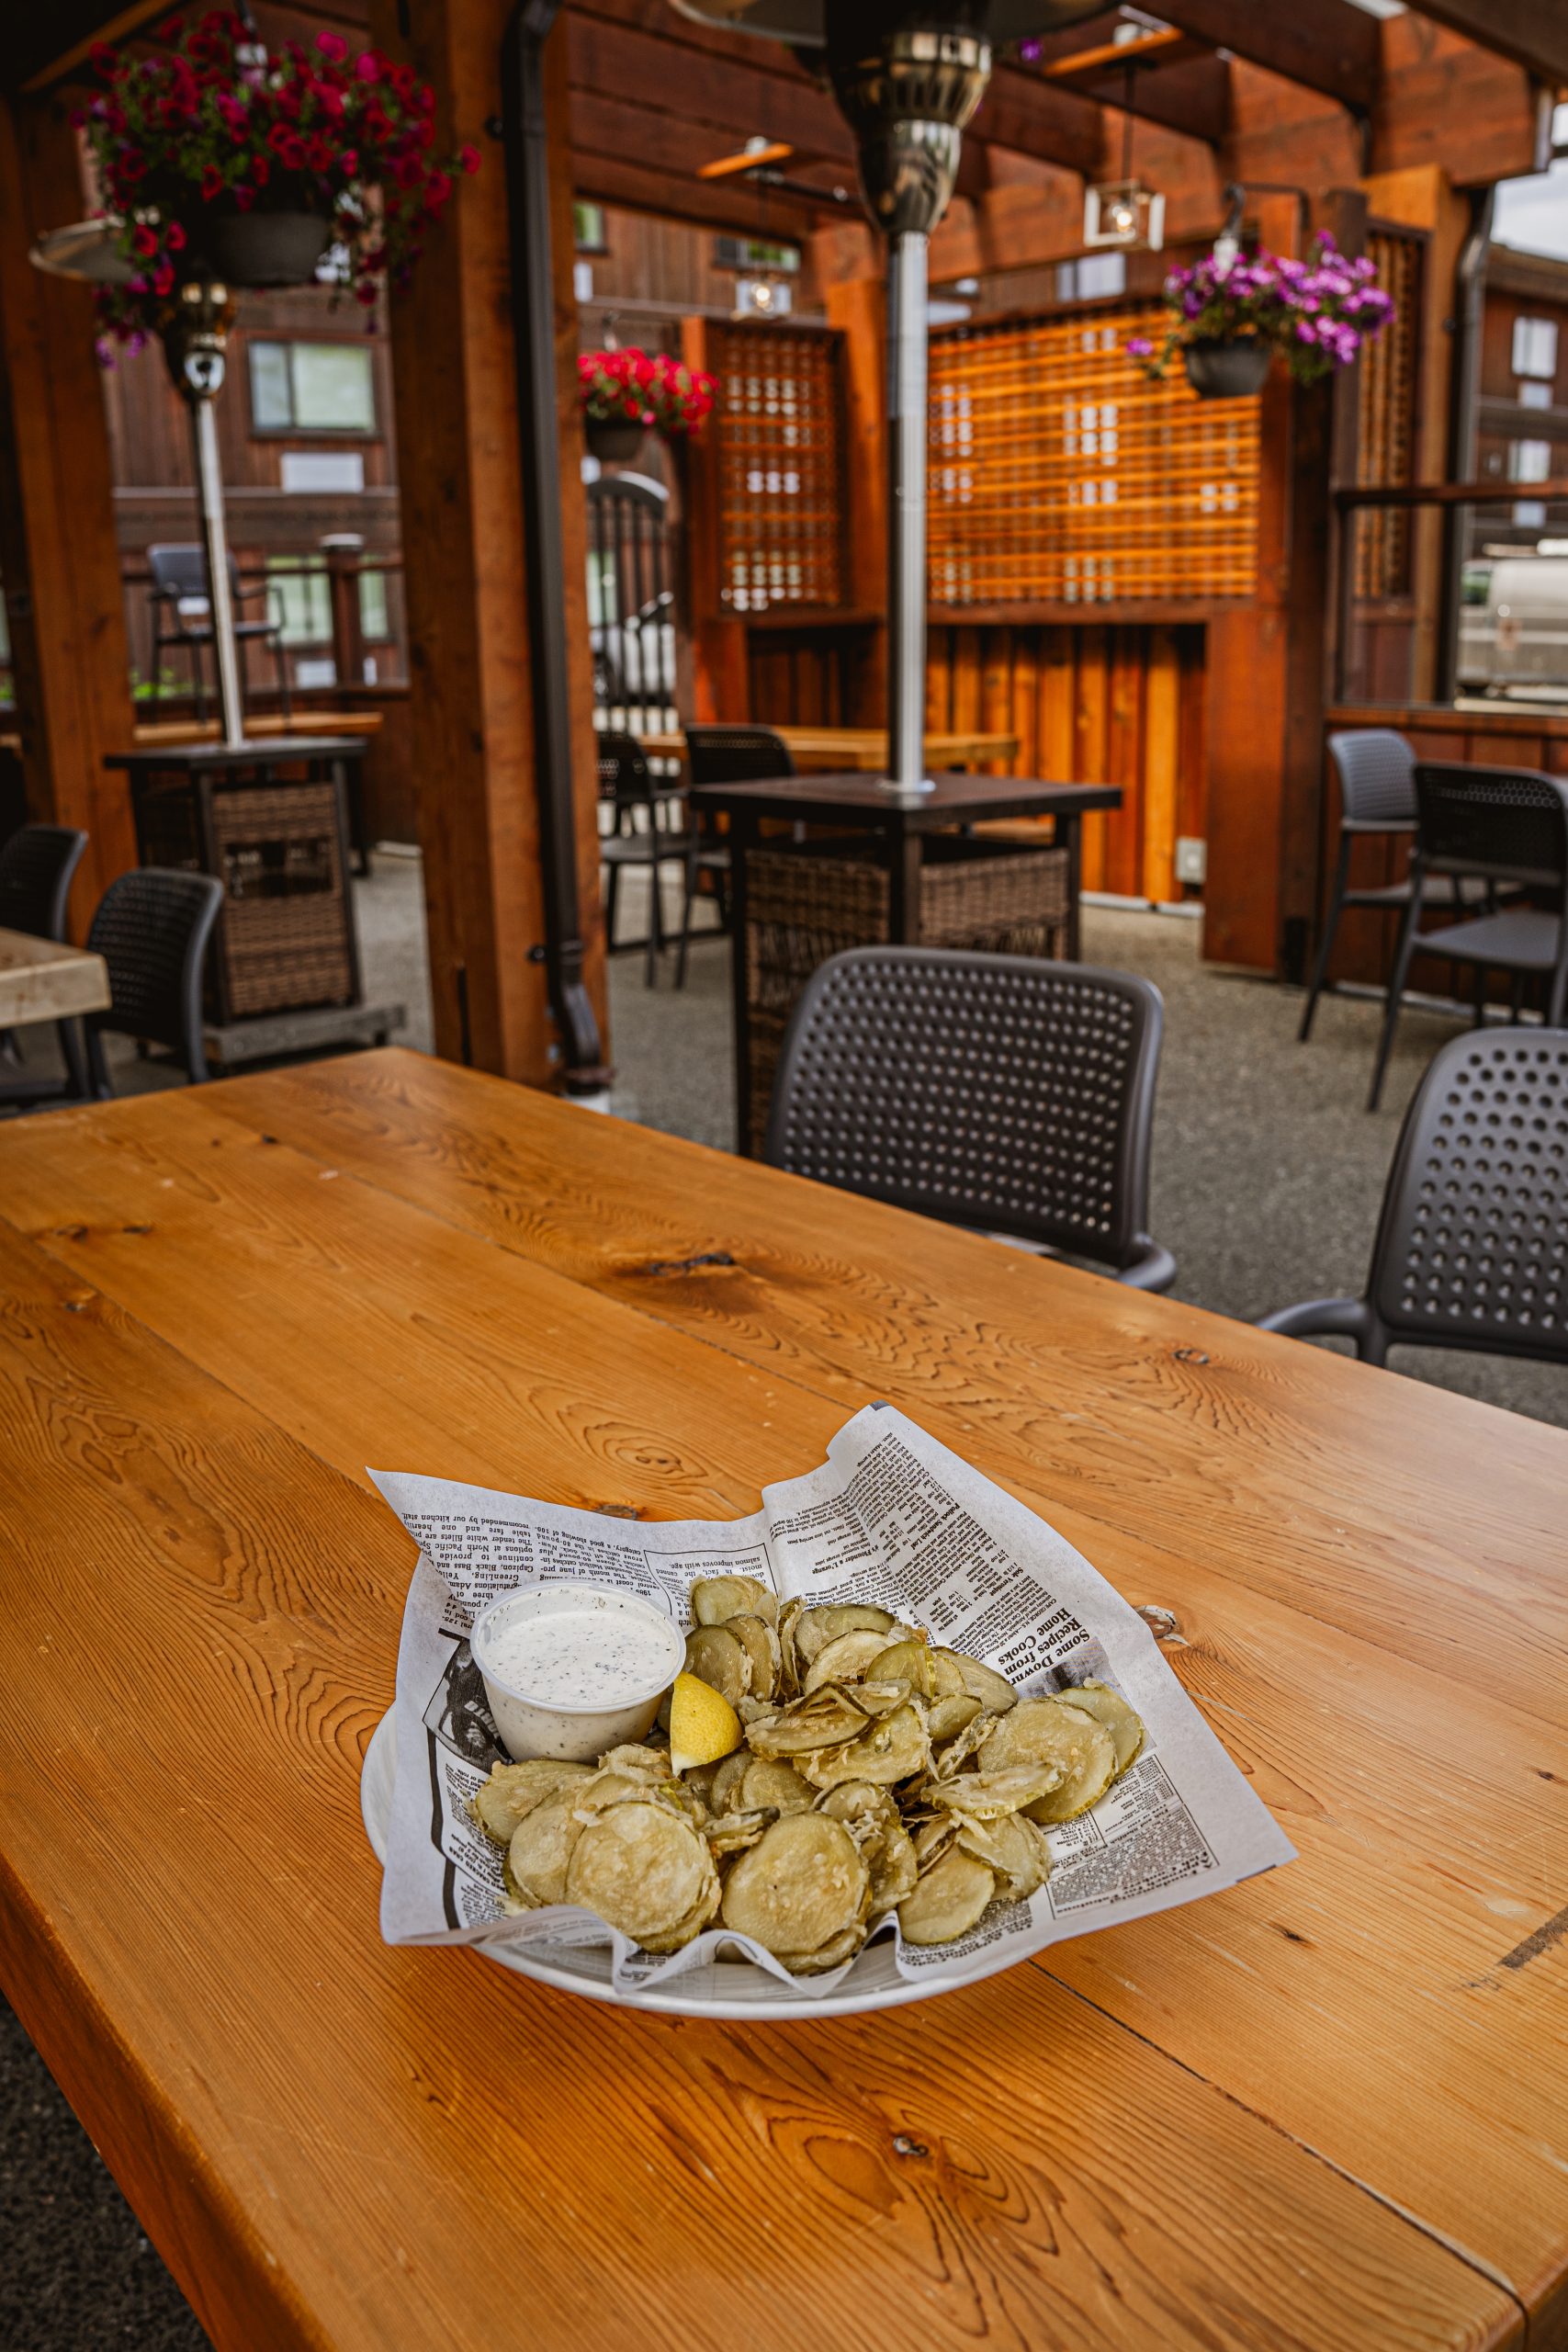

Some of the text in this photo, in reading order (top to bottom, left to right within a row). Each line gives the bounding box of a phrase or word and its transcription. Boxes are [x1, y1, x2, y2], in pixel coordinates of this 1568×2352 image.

[941, 1502, 960, 1521] Pollock
[480, 1519, 528, 1528] recommended
[512, 1530, 530, 1538] table
[920, 1519, 942, 1541] Sandwich
[491, 1536, 514, 1544] tender
[561, 1531, 586, 1543] showing
[505, 1545, 532, 1554] options
[439, 1552, 471, 1560] provide
[845, 1549, 872, 1562] Flounder
[735, 1556, 760, 1565] salmon
[501, 1563, 533, 1572] Capizon,
[739, 1564, 761, 1572] moist.
[613, 1572, 626, 1580] The
[989, 1566, 1023, 1596] Sole Veronique
[998, 1607, 1070, 1666] Home Cooks
[1006, 1617, 1080, 1676] Recipes from
[1055, 1628, 1090, 1657] Some
